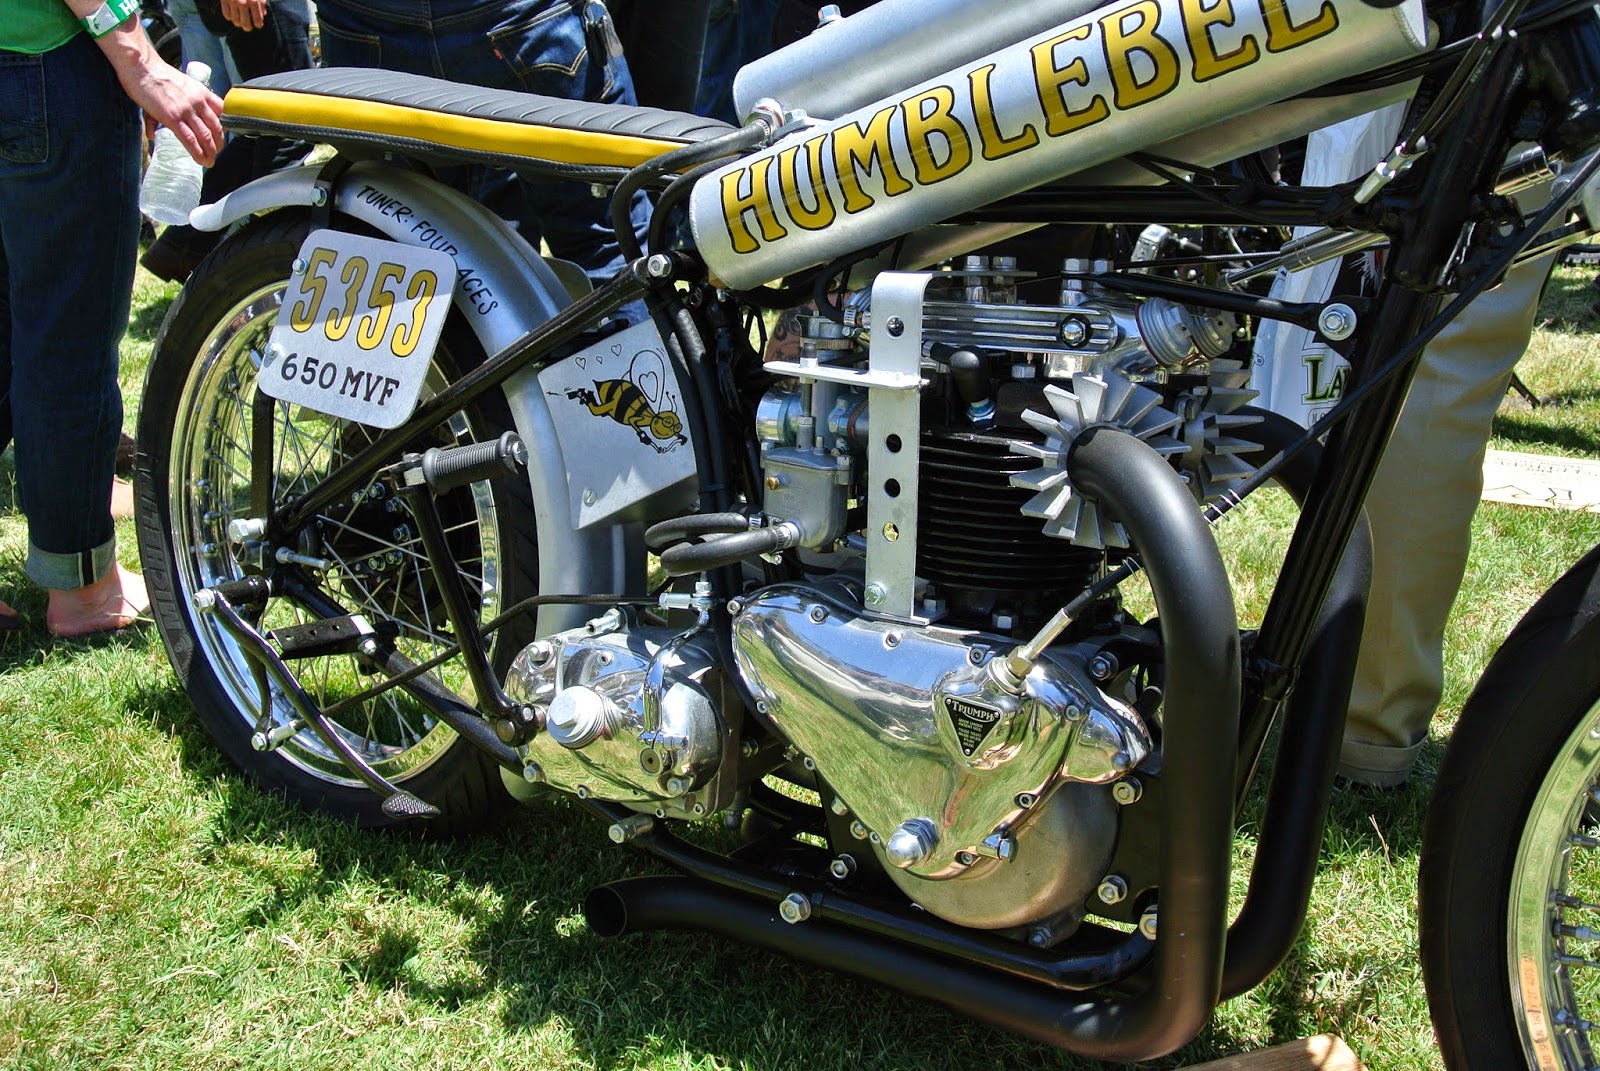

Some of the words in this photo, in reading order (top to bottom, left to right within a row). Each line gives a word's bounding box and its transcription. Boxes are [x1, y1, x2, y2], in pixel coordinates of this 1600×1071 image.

[356, 185, 415, 223] TUNER:
[458, 269, 498, 315] ACES
[290, 247, 438, 358] 5353
[281, 353, 337, 389] 650
[339, 366, 400, 406] MVF
[952, 701, 995, 721] TRIUMPH
